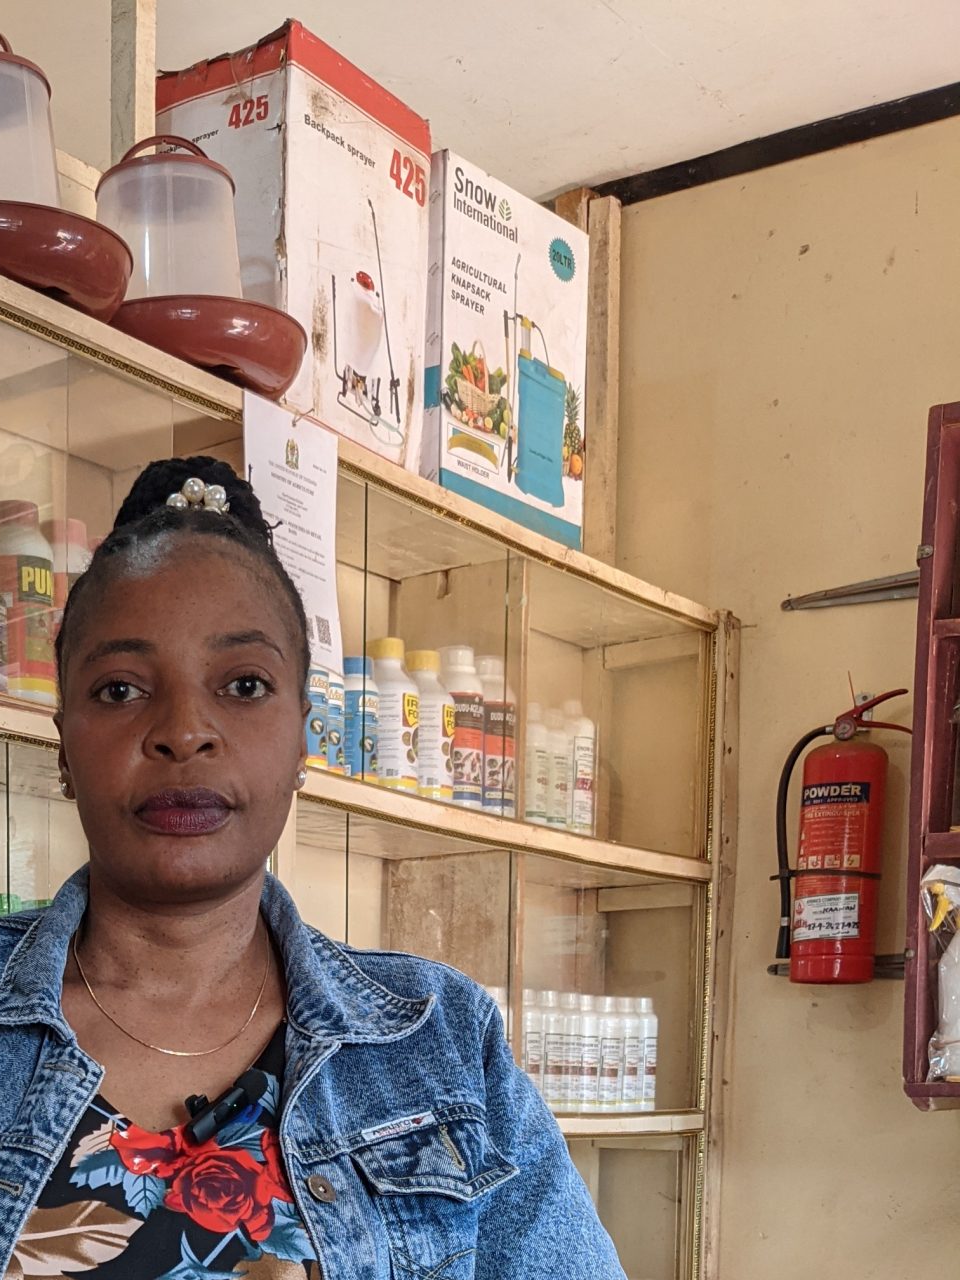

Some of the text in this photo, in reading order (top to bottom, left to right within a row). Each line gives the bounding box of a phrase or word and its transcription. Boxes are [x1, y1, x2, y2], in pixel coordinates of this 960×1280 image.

[228, 95, 268, 130] 425
[191, 130, 218, 144] sprayer
[304, 114, 376, 168] Backpack sprayer
[390, 148, 426, 208] 425
[454, 166, 496, 212] Snow
[454, 192, 518, 244] International
[452, 257, 507, 294] AGRICULTURAL
[552, 250, 572, 270] 20LTR
[451, 274, 491, 302] KNAPSACK
[451, 290, 484, 316] SPRAYER
[456, 460, 489, 479] WAIST HOLDER
[804, 784, 861, 799] POWDER
